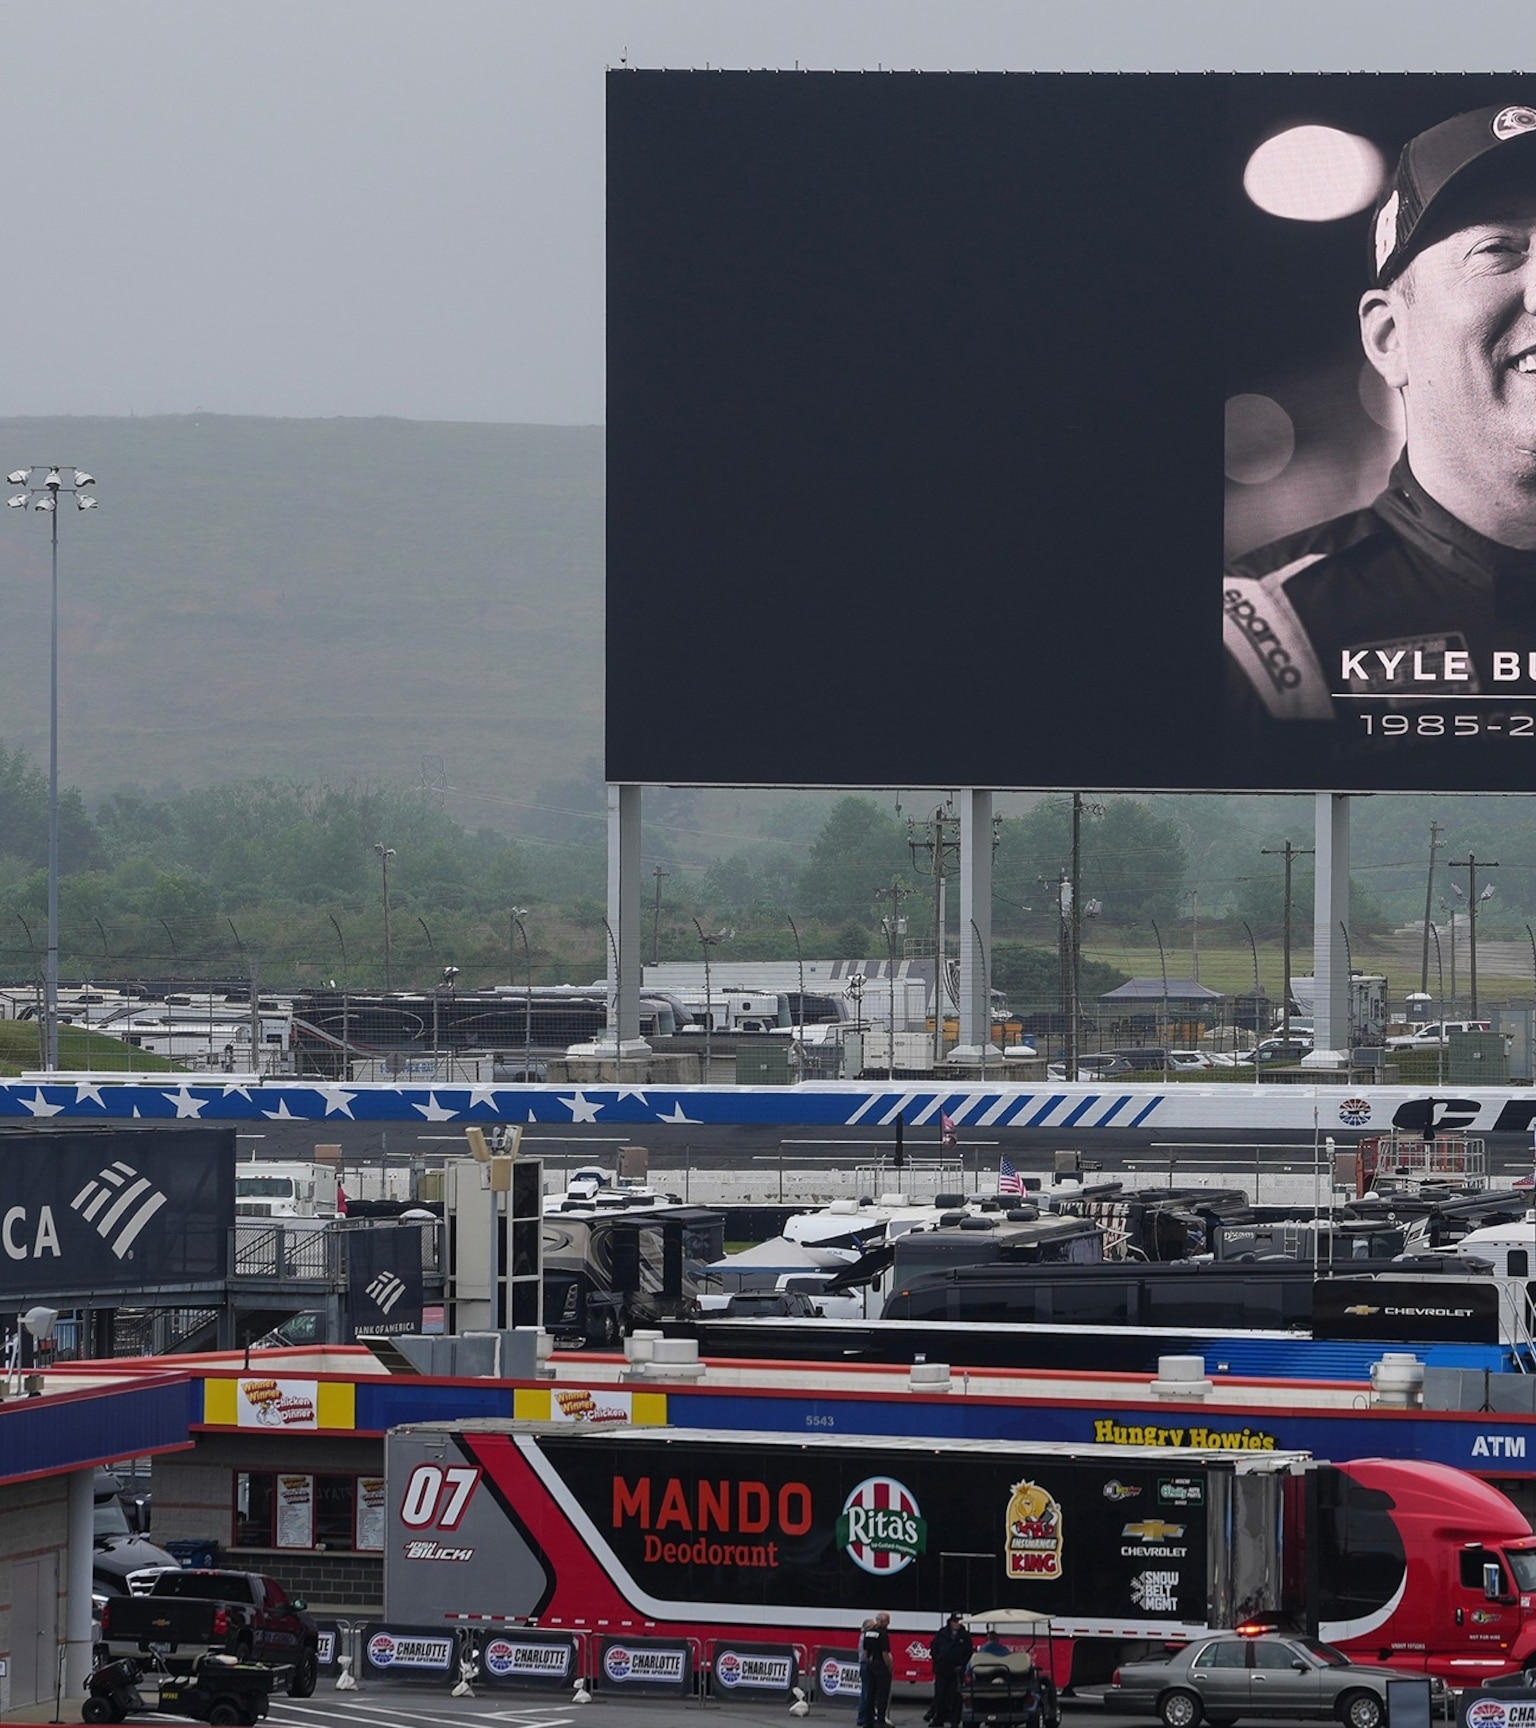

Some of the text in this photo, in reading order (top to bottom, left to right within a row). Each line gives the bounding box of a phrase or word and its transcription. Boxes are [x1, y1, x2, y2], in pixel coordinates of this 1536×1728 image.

[1341, 650, 1470, 681] KYLE
[1384, 1307, 1474, 1317] CHEVROLET
[354, 1322, 415, 1336] BANK OF AMERICA
[243, 1380, 277, 1392] Winner
[247, 1390, 282, 1403] Winner
[274, 1396, 313, 1411] Chicken
[555, 1390, 591, 1404] Winner
[560, 1401, 597, 1415] Winner
[587, 1407, 627, 1421] Chicken
[281, 1408, 314, 1424] Dinner
[806, 1415, 834, 1426] 5543
[1094, 1419, 1276, 1450] Hungry Howie's
[1471, 1435, 1526, 1457] ATM
[401, 1465, 480, 1528] 07
[613, 1476, 812, 1535] MANDO
[848, 1506, 919, 1544] Rita's
[644, 1535, 779, 1567] Deodorant
[1011, 1538, 1058, 1550] INSURANCE
[407, 1548, 474, 1561] BILICKI
[1121, 1546, 1187, 1557] CHEVROLET
[1011, 1552, 1057, 1572] KING
[1145, 1571, 1179, 1585] SNOW
[1145, 1585, 1173, 1597] BELT
[1145, 1597, 1178, 1611] MGMT
[397, 1642, 448, 1658] CHARLOTTE
[514, 1648, 565, 1665] CHARLOTTE
[632, 1654, 680, 1670] CHARLOTTE
[741, 1660, 787, 1677] CHARLOTTE
